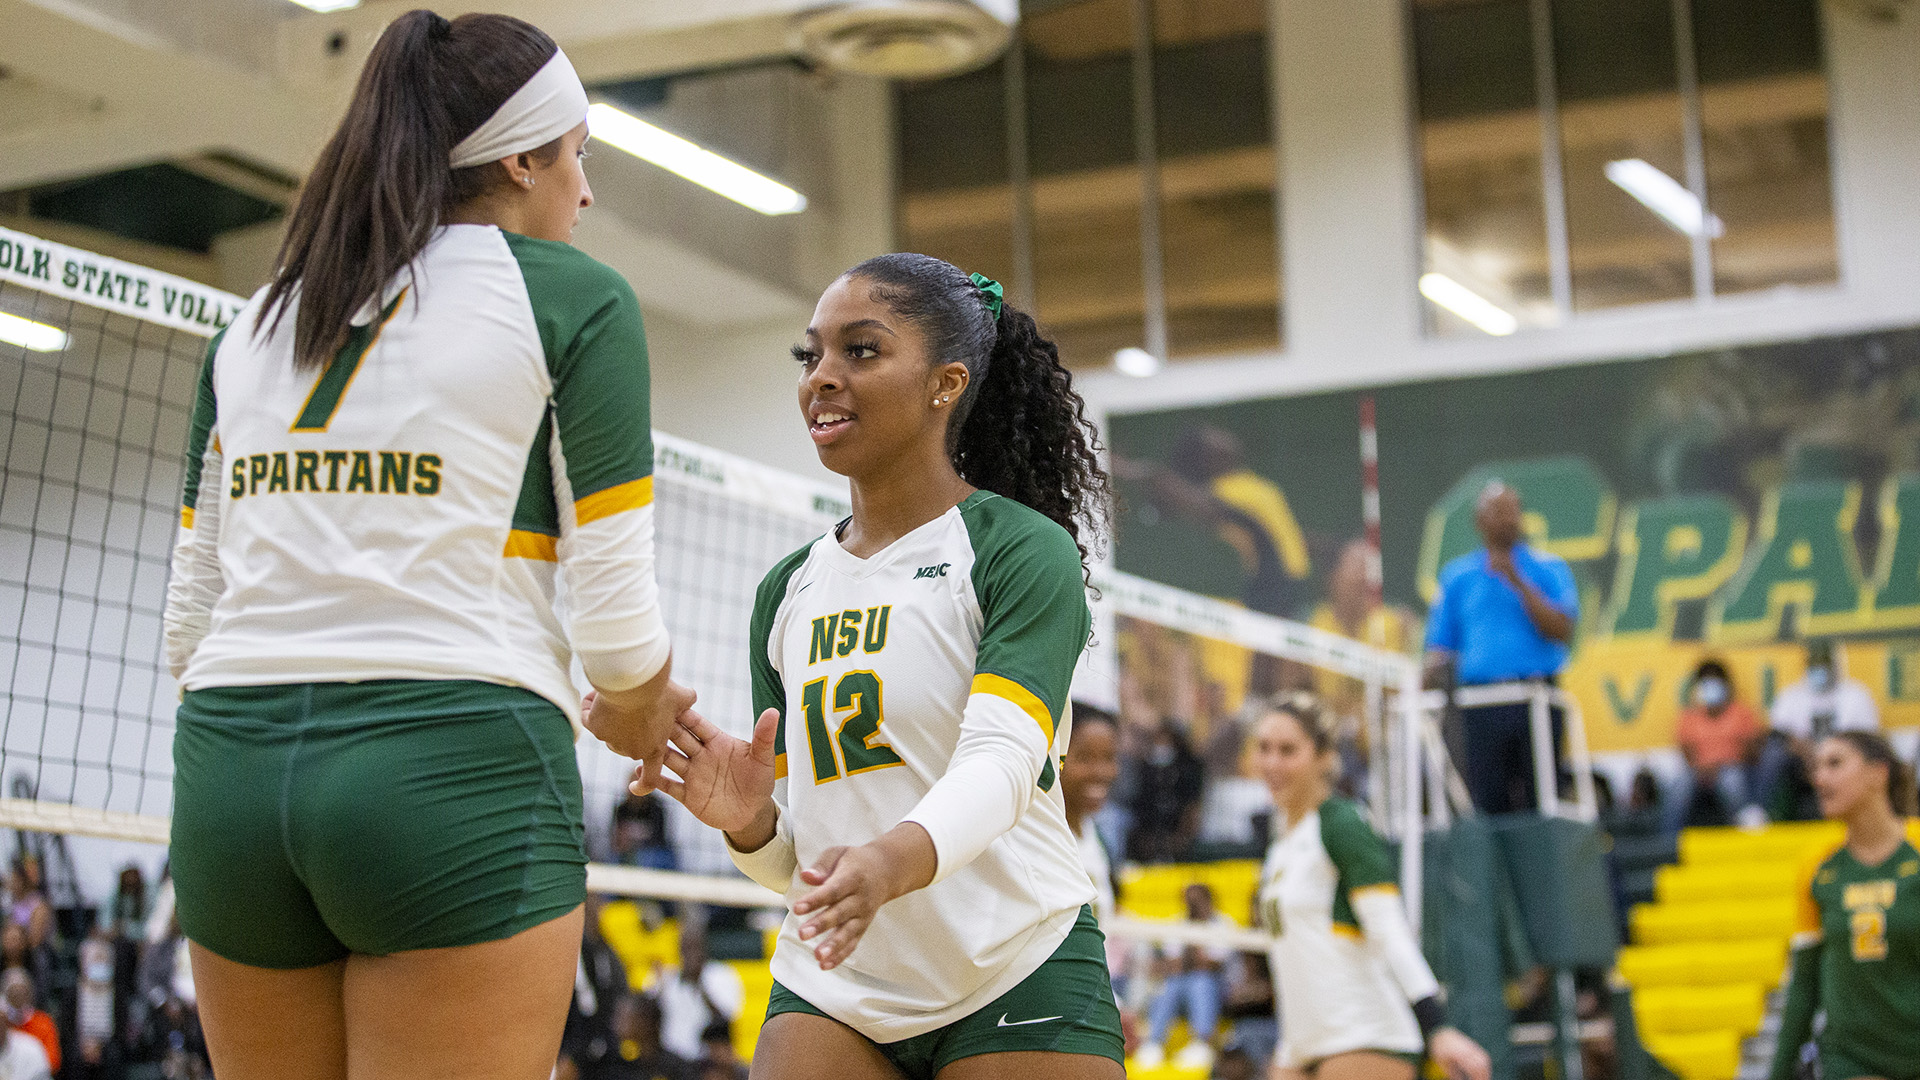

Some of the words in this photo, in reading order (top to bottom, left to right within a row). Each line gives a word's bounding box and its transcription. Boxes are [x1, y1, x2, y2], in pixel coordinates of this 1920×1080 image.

[62, 259, 150, 308] STATE
[162, 286, 240, 329] VOLL
[230, 450, 443, 499] SPARTANS
[1416, 455, 1920, 646] SPA
[808, 605, 893, 667] NSU
[801, 669, 906, 786] 12
[1850, 911, 1888, 961] 2
